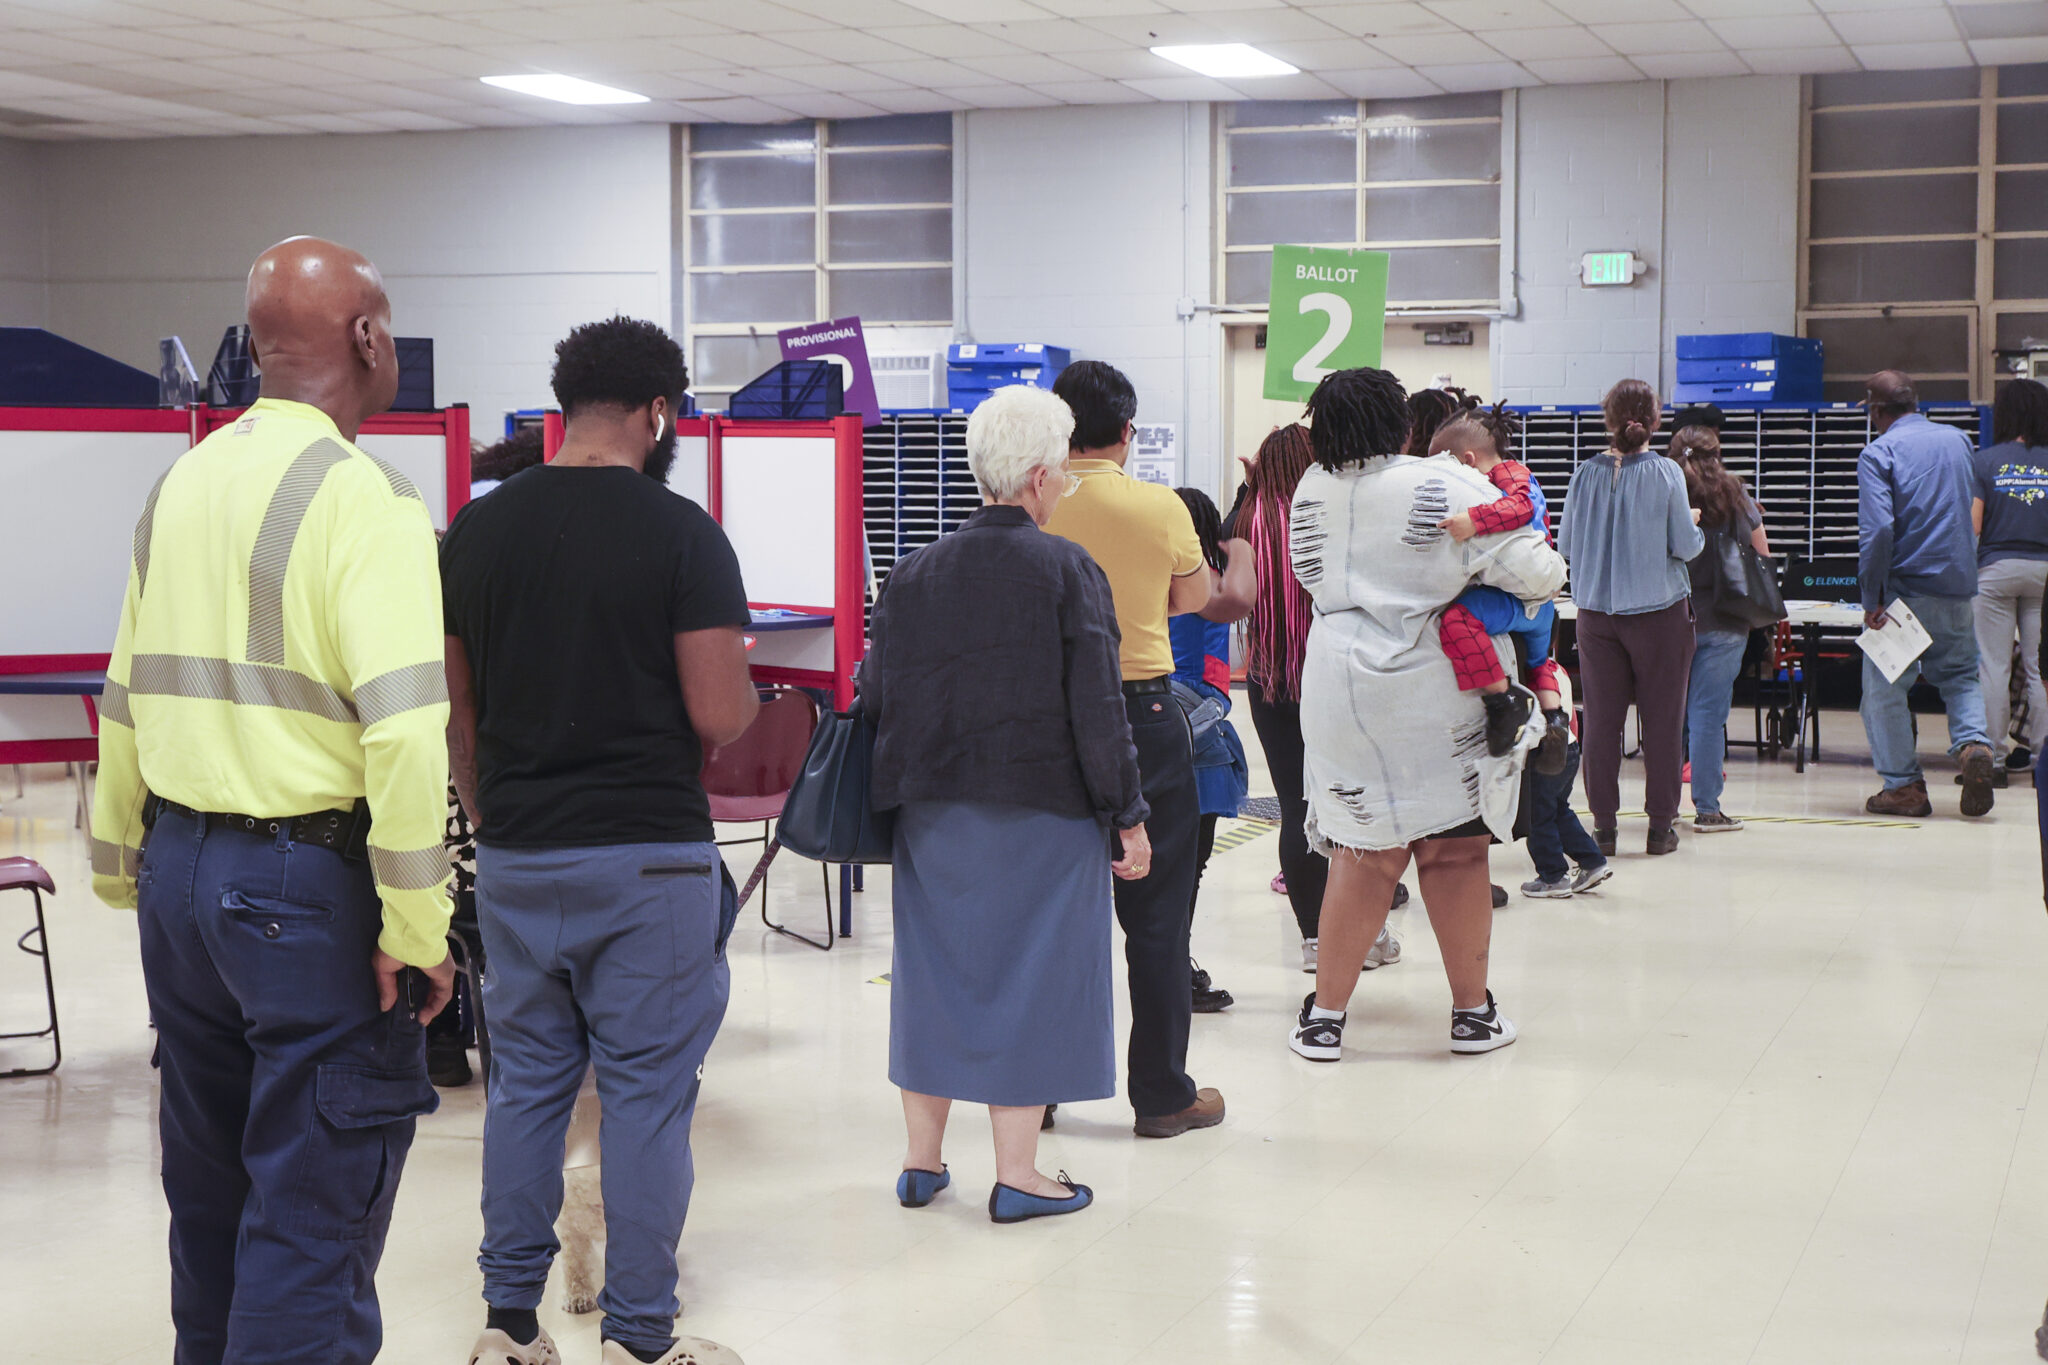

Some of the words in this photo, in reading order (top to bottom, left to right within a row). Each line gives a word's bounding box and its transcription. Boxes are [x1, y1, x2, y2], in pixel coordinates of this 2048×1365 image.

[1296, 264, 1358, 283] BALLOT
[1592, 254, 1627, 283] EXIT
[786, 327, 857, 349] PROVISIONAL
[1292, 292, 1353, 384] 2
[1815, 576, 1857, 586] ELENKER
